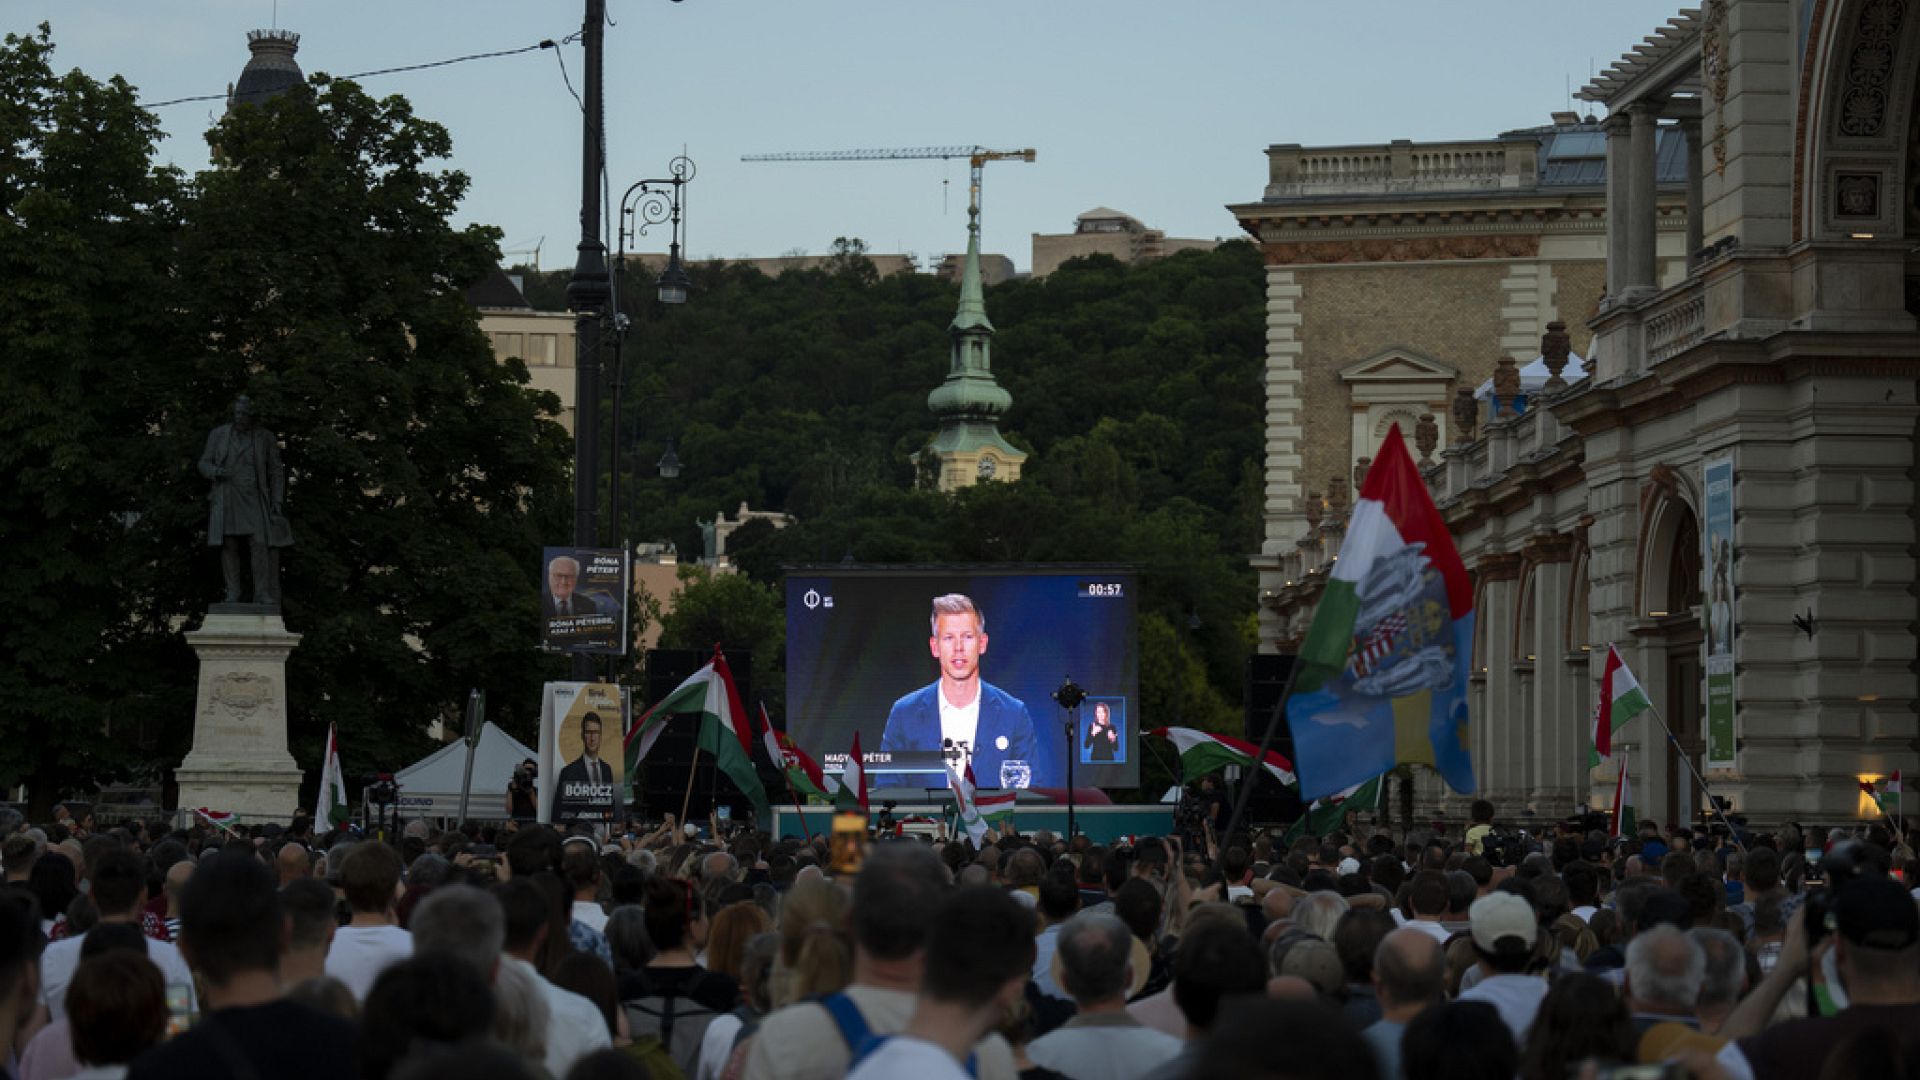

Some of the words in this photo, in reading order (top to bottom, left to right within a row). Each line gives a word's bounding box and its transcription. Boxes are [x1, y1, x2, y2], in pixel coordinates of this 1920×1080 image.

[1088, 583, 1122, 596] 00:57
[824, 753, 851, 763] MAGY
[862, 752, 892, 763] PÉTER
